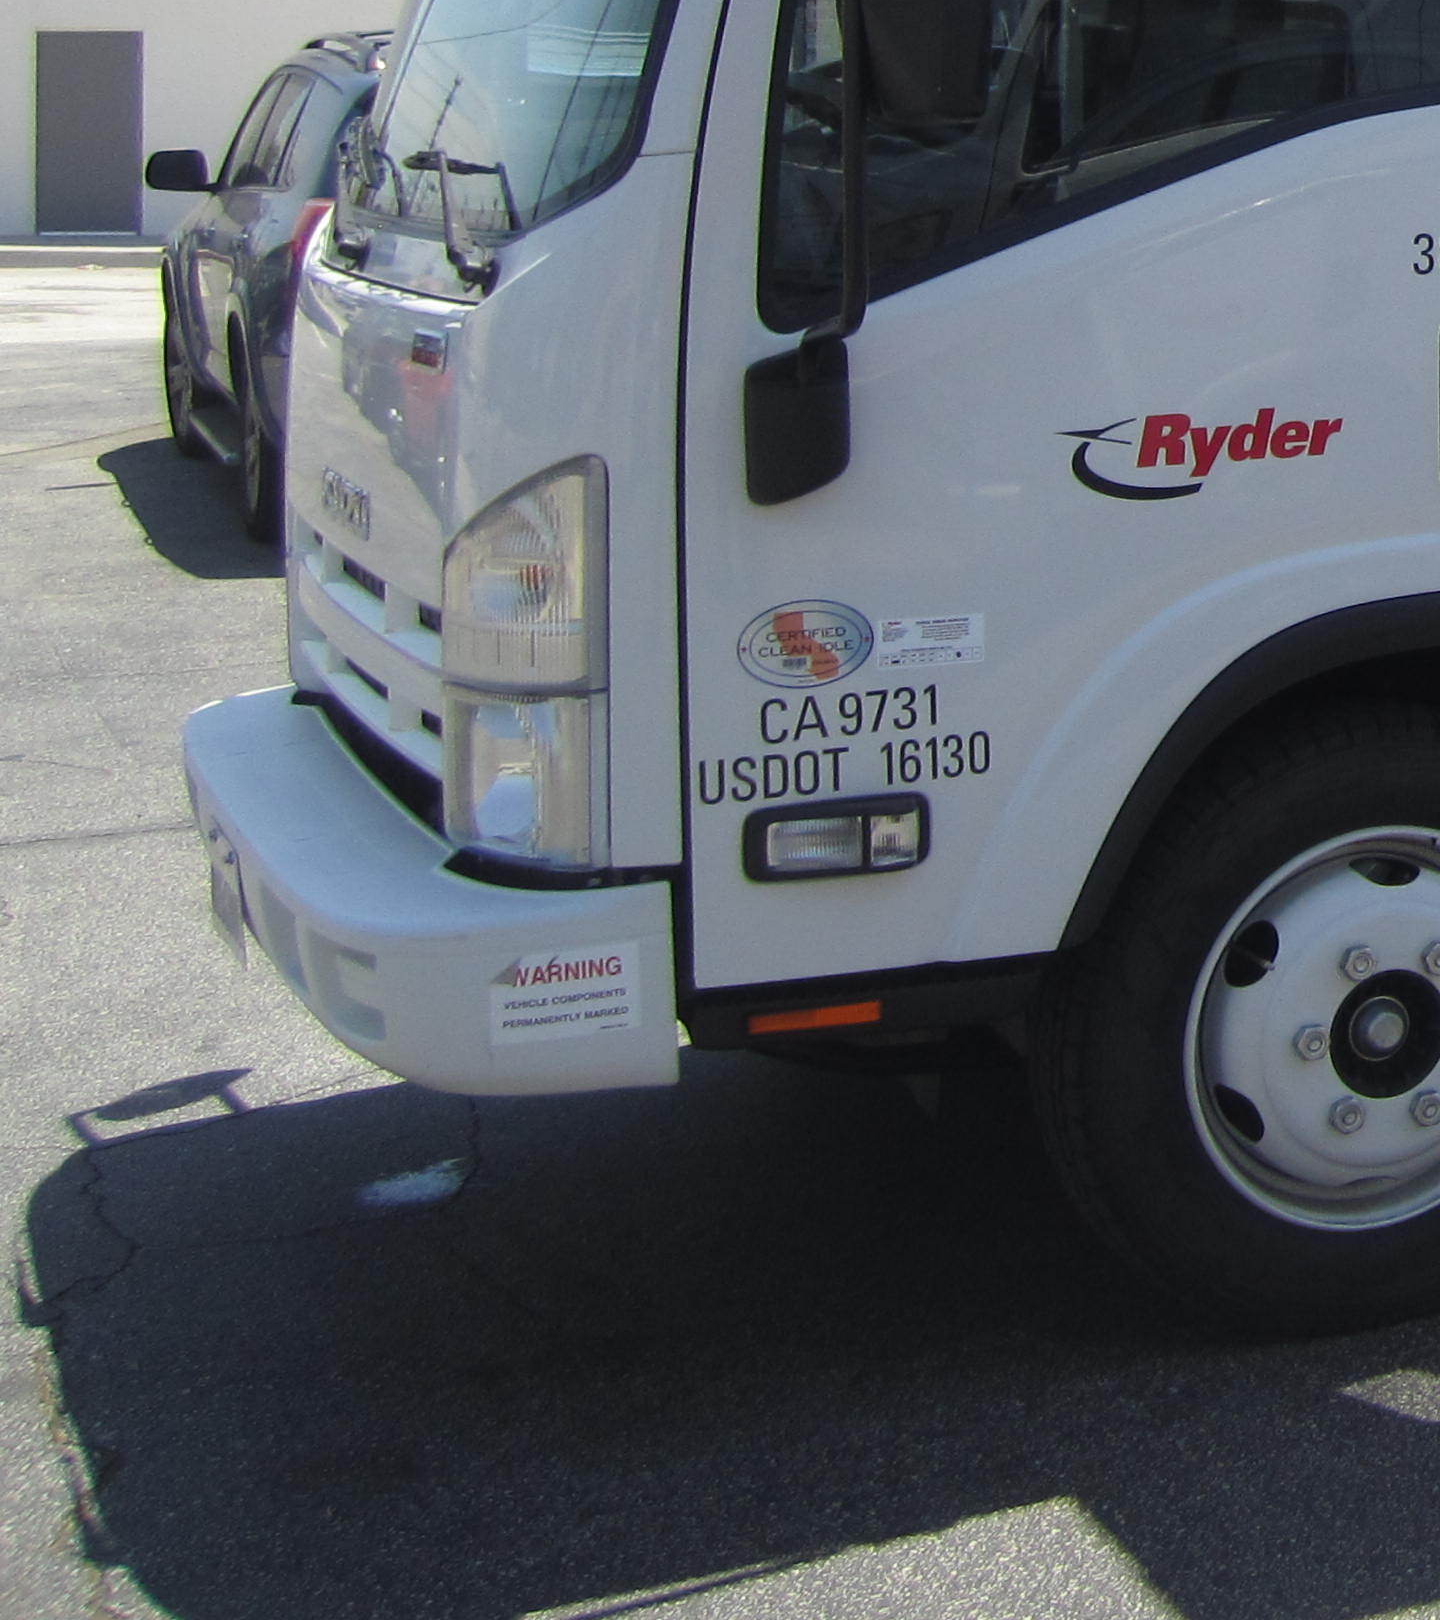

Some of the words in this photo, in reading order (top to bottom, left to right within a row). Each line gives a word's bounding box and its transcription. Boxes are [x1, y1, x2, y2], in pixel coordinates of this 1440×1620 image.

[1136, 408, 1343, 477] Ryder
[766, 626, 847, 642] CERTIFIED
[758, 643, 813, 658] CLEAN
[820, 639, 854, 652] IDLE
[760, 695, 829, 744] CA
[838, 684, 938, 736] 9731
[699, 746, 849, 804] USDOT
[880, 731, 990, 786] 16130
[512, 956, 622, 987] WARNING
[503, 997, 548, 1010] VEHICLE
[552, 987, 626, 1005] COMPONENTS
[503, 1012, 581, 1029] PERMANENTLY
[584, 1006, 629, 1021] MARKED
